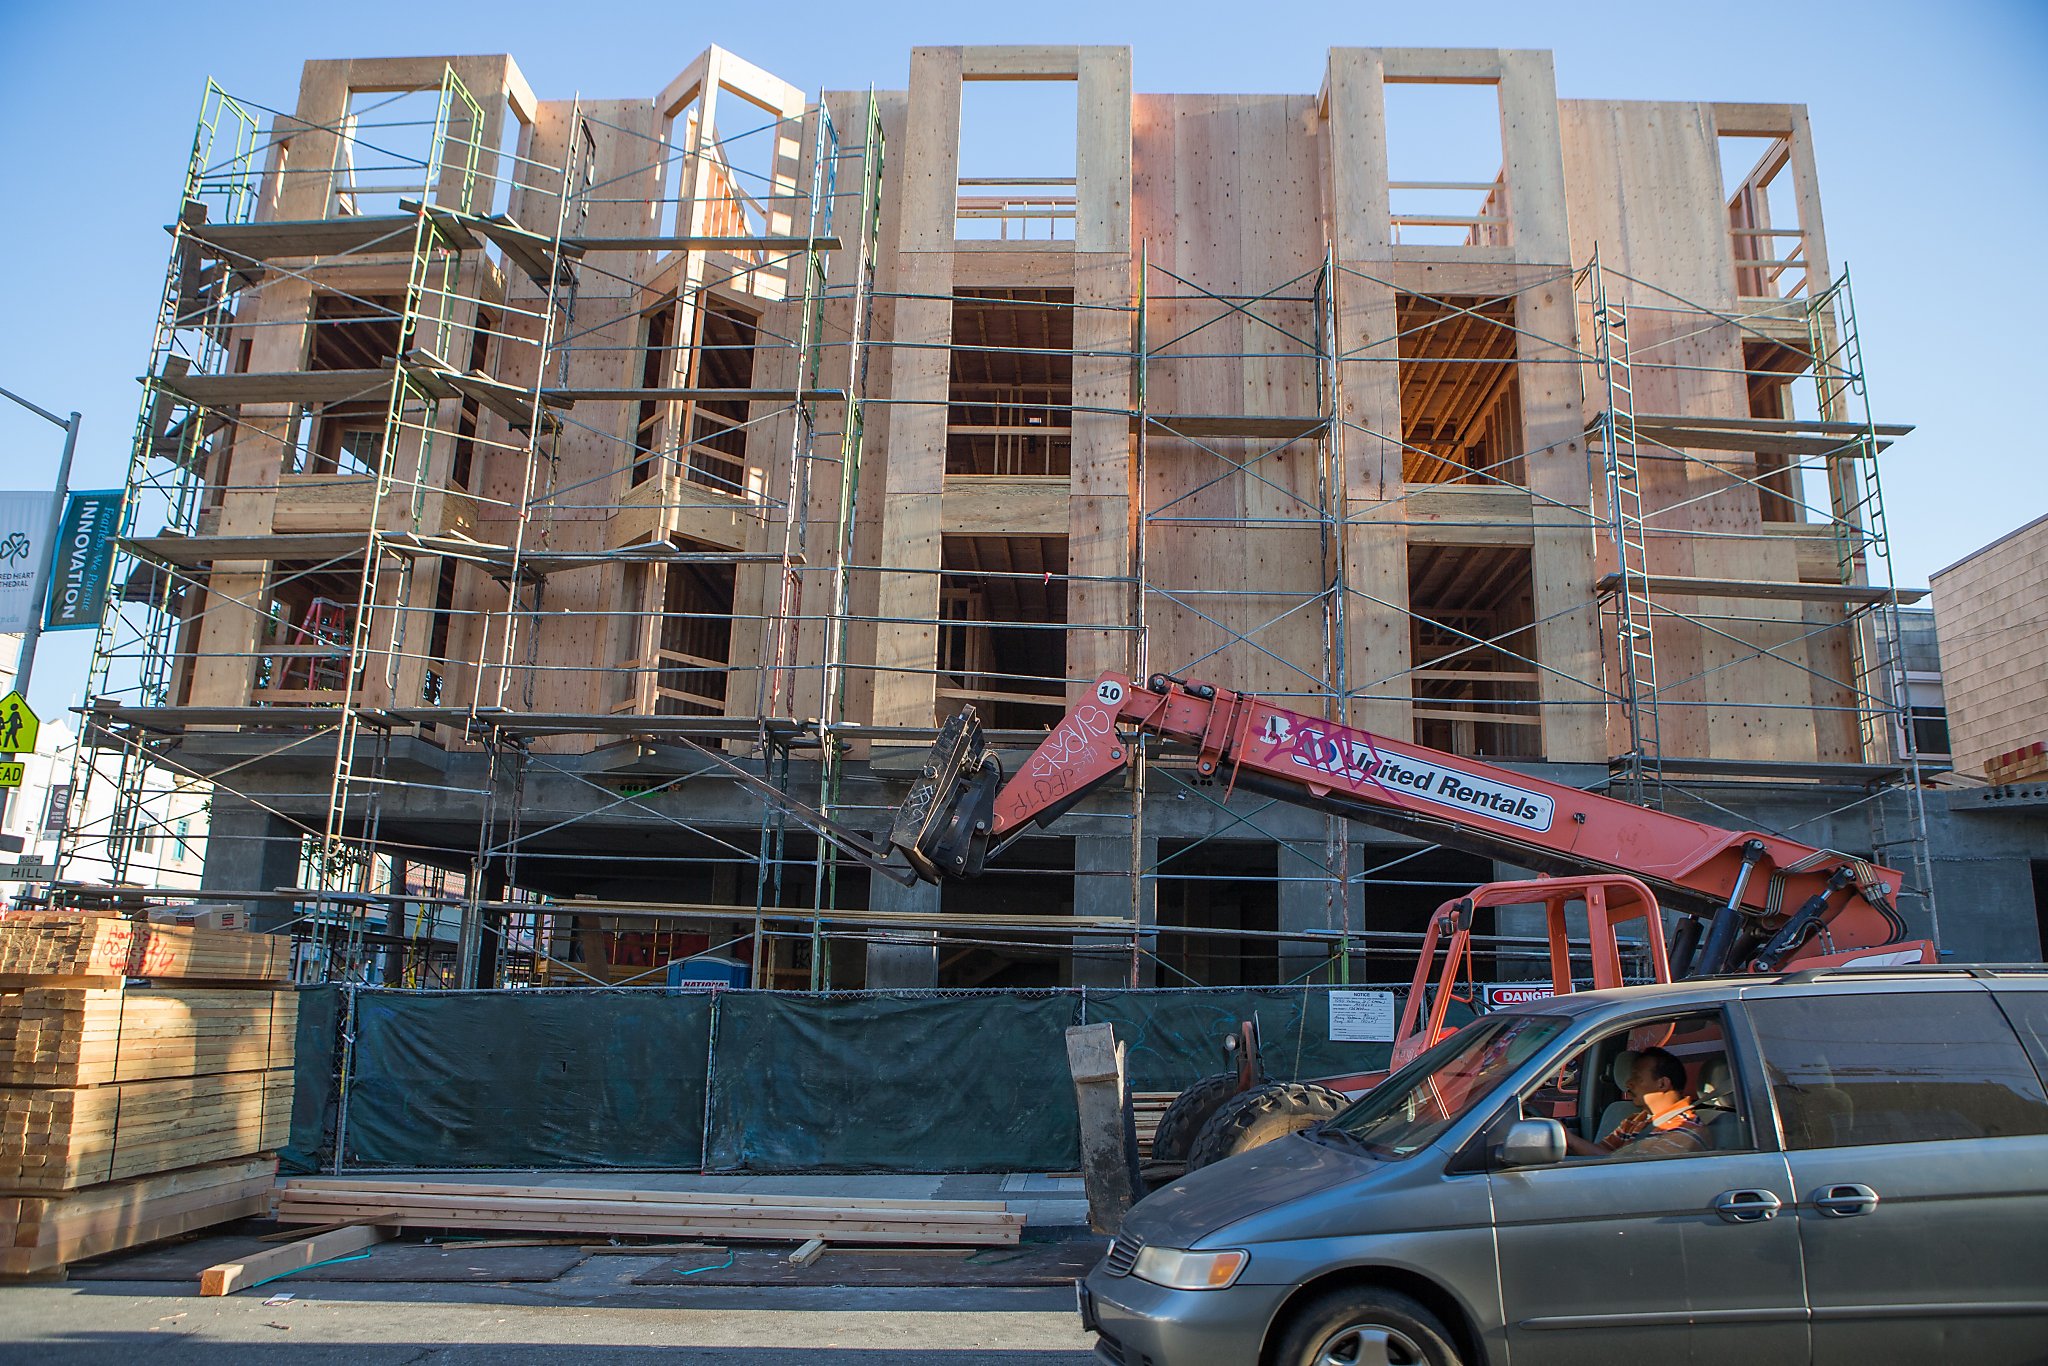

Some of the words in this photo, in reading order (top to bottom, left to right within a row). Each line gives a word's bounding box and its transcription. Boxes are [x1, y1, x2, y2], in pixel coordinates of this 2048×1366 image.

[62, 501, 99, 619] INNOVATION
[91, 554, 103, 571] We
[13, 572, 35, 580] HEART
[82, 573, 98, 611] Pursue
[1099, 685, 1119, 700] 10
[1346, 750, 1435, 791] United
[1437, 775, 1539, 820] Rentals
[11, 868, 43, 879] HILL
[1503, 991, 1554, 1002] DANGE
